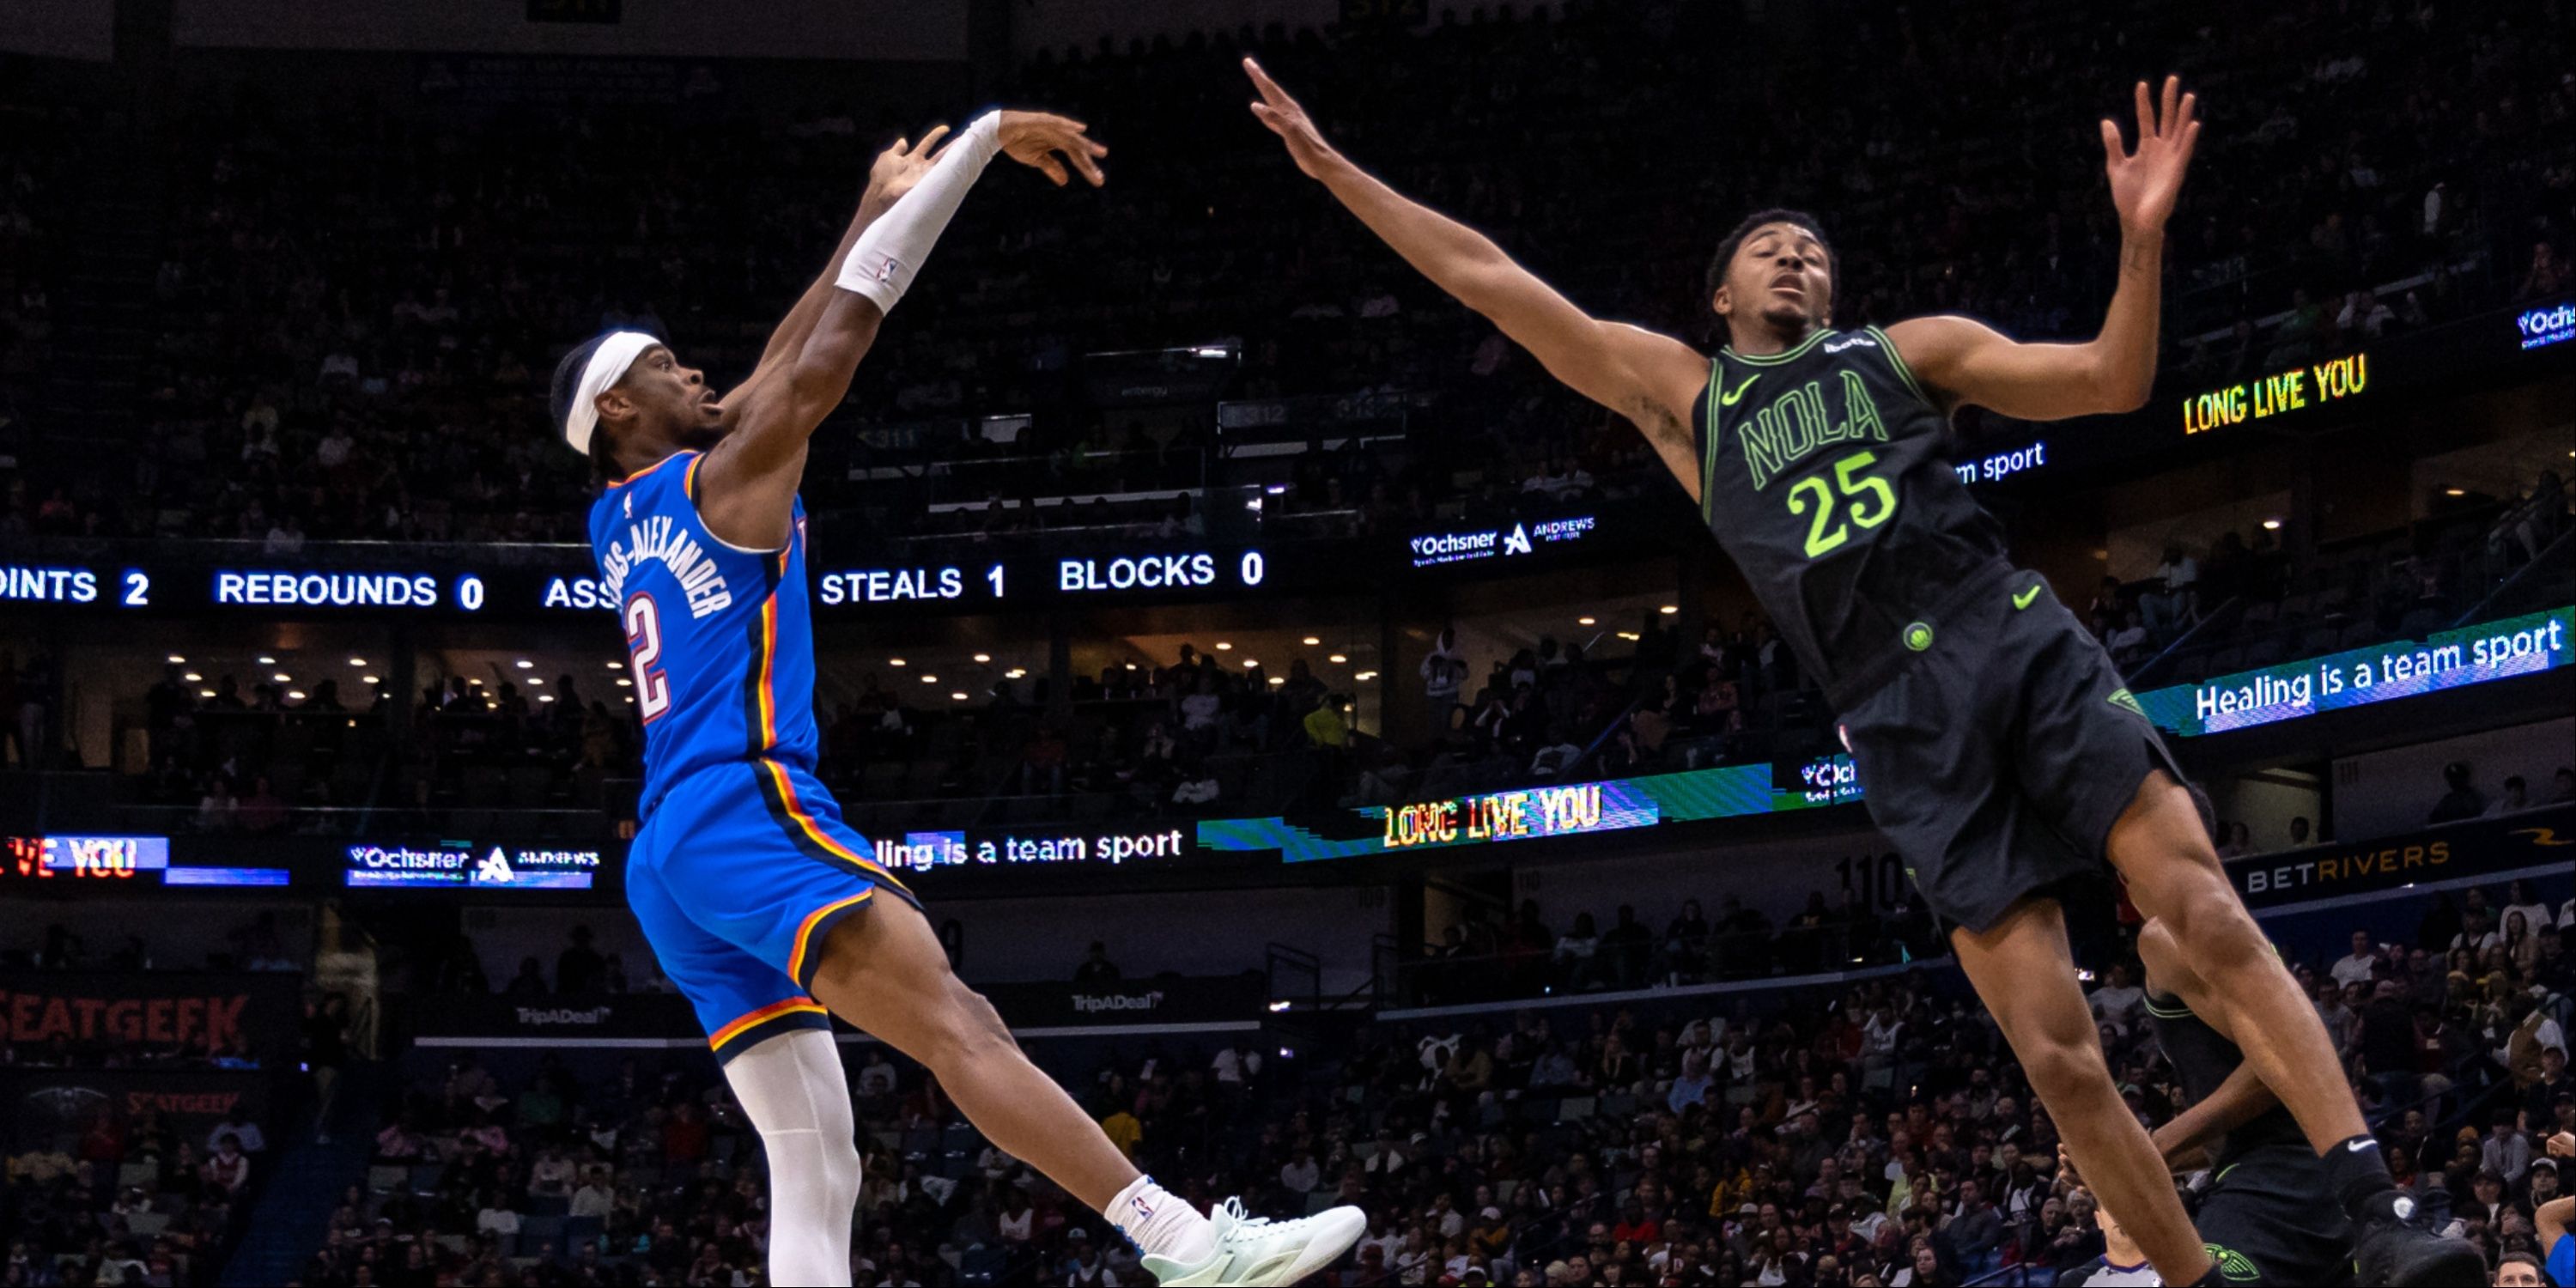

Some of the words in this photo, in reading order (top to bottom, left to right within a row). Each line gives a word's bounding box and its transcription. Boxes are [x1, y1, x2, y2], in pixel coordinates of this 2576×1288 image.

[2183, 386, 2247, 434] LONG
[2253, 369, 2306, 419] LIVE
[2313, 353, 2366, 402] YOU
[1739, 370, 1889, 491] NOLA
[1983, 443, 2044, 482] sport
[1788, 451, 1896, 558] 25
[1422, 532, 1498, 556] Ochsner
[1533, 517, 1595, 538] ANDREWS
[0, 568, 97, 602] INTS
[125, 573, 149, 605] 2
[821, 568, 963, 605] STEALS
[987, 565, 1004, 598] 1
[1060, 554, 1215, 591] BLOCKS
[1242, 552, 1263, 585] 0
[219, 574, 438, 606] REBOUNDS
[460, 578, 484, 610] 0
[624, 590, 672, 726] 2
[2196, 673, 2311, 720] Healing
[2320, 664, 2343, 696] is
[2354, 663, 2372, 689] a
[2382, 644, 2461, 683] team
[2473, 619, 2561, 669] sport
[1467, 793, 1528, 839] LIVE
[1539, 785, 1601, 832] YOU
[69, 837, 137, 877] YOU
[363, 846, 471, 868] Ochsner
[945, 837, 969, 865] is
[977, 840, 997, 863] a
[1006, 835, 1086, 862] team
[1097, 829, 1182, 865] sport
[1836, 853, 1904, 913] 110
[2247, 840, 2451, 895] BETRIVERS
[0, 992, 250, 1053] EATGEEK
[1072, 993, 1152, 1013] TripADeal
